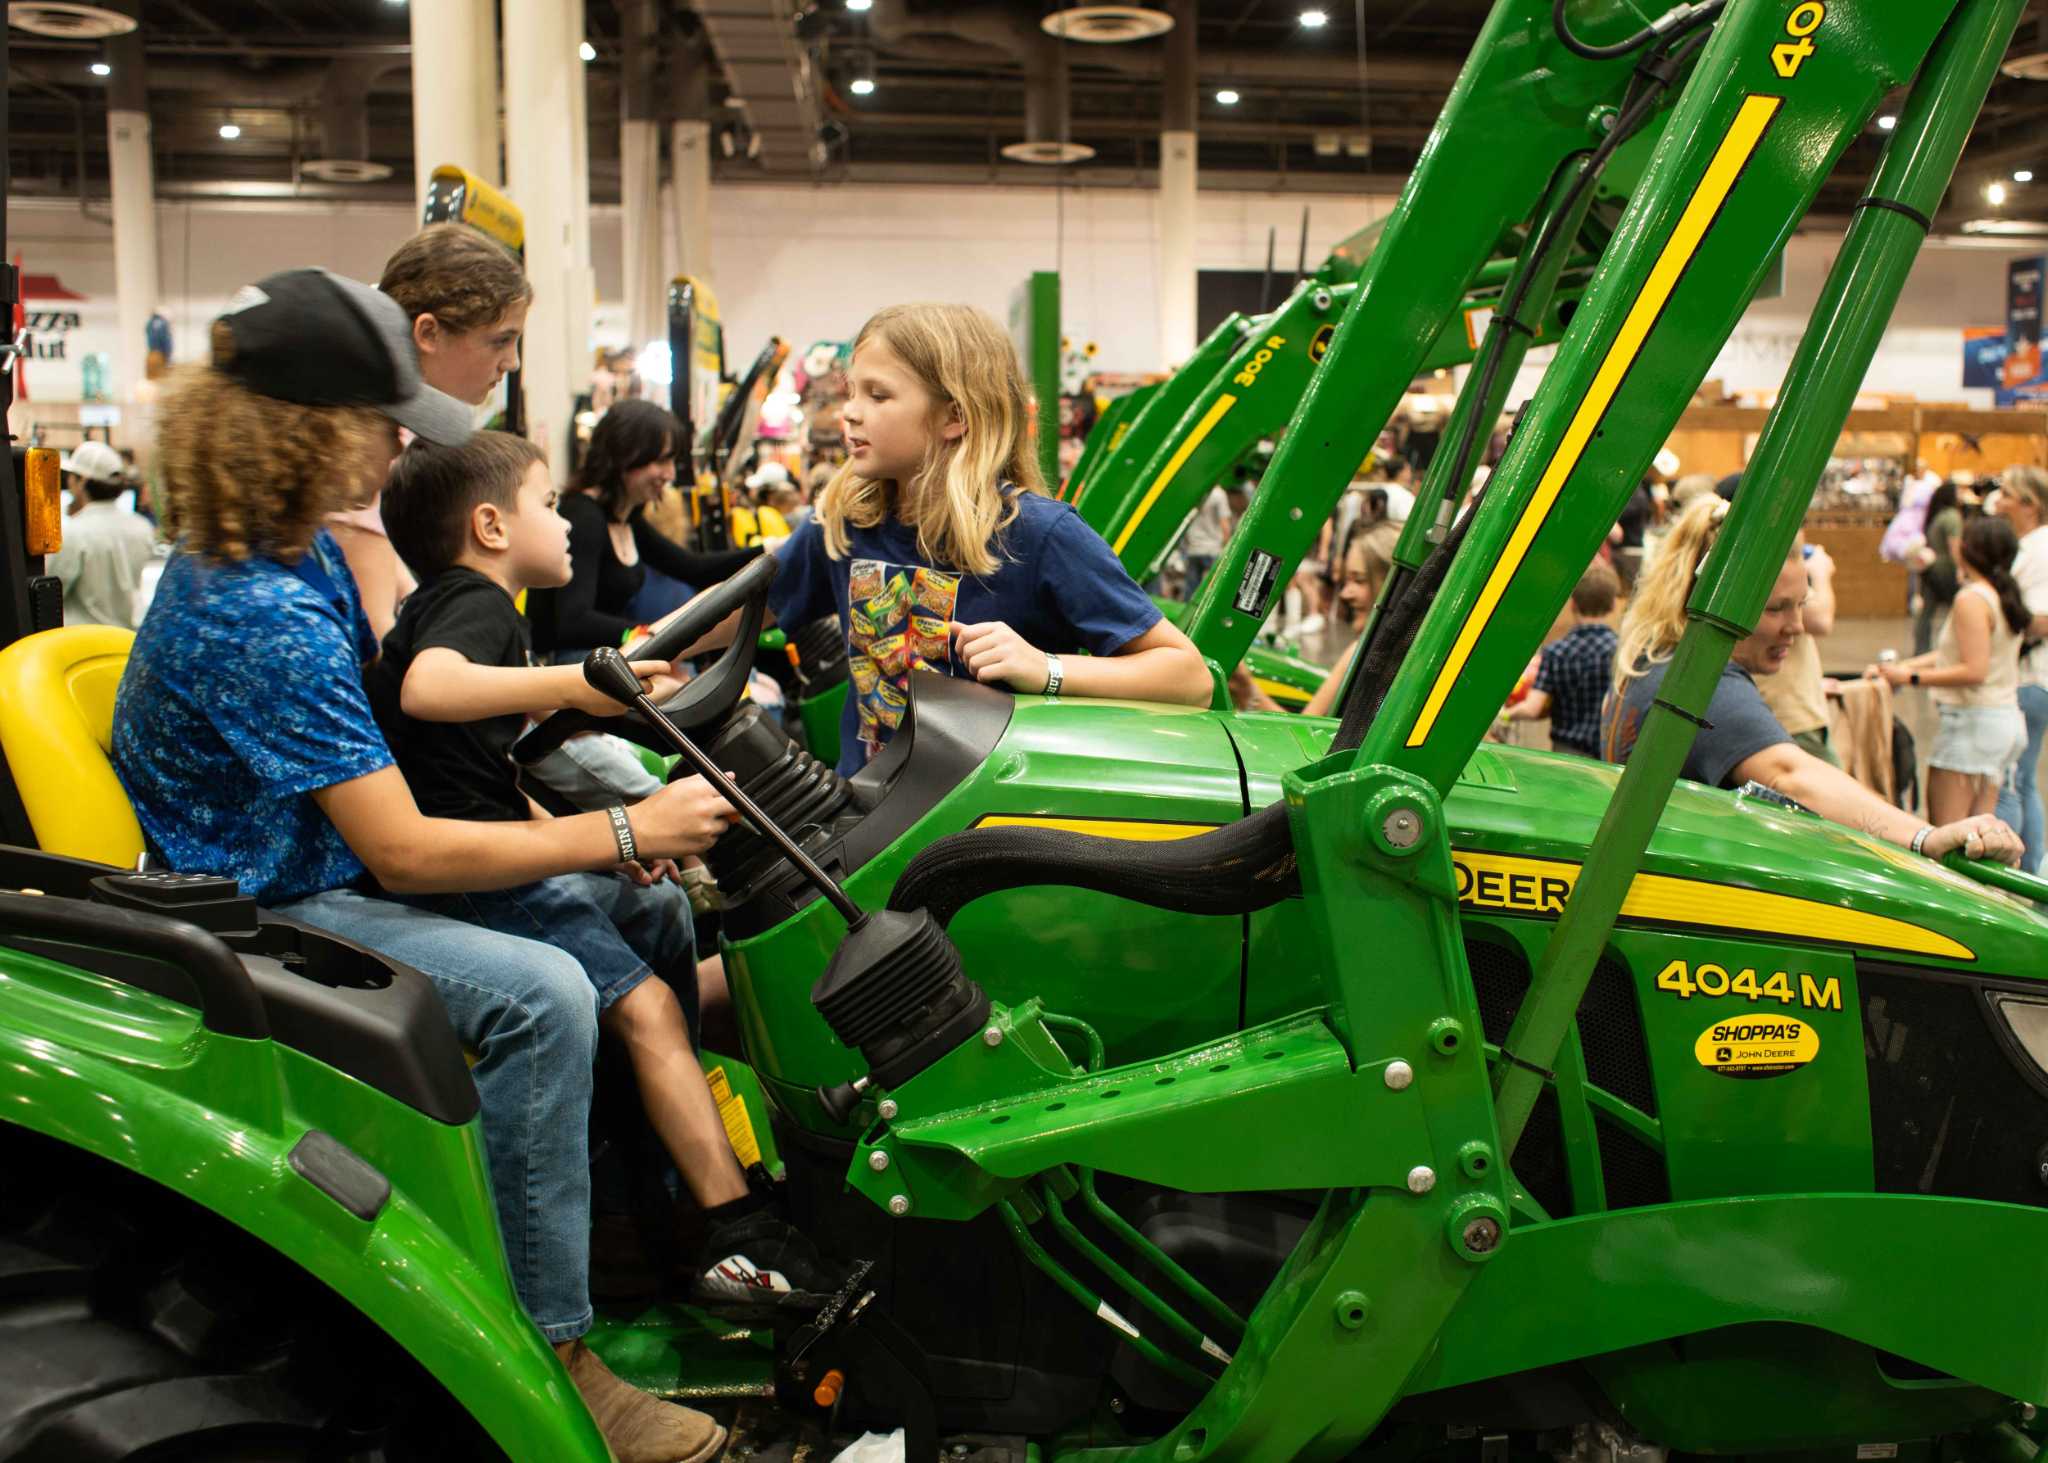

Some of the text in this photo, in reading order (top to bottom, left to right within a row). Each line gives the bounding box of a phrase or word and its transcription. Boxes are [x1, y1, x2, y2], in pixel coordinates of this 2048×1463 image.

[1770, 0, 1826, 78] 40
[26, 311, 79, 332] zza
[1454, 860, 1570, 908] DEER
[1712, 1024, 1801, 1042] SHOPPA'S
[1736, 1049, 1796, 1060] JOHN DEERE
